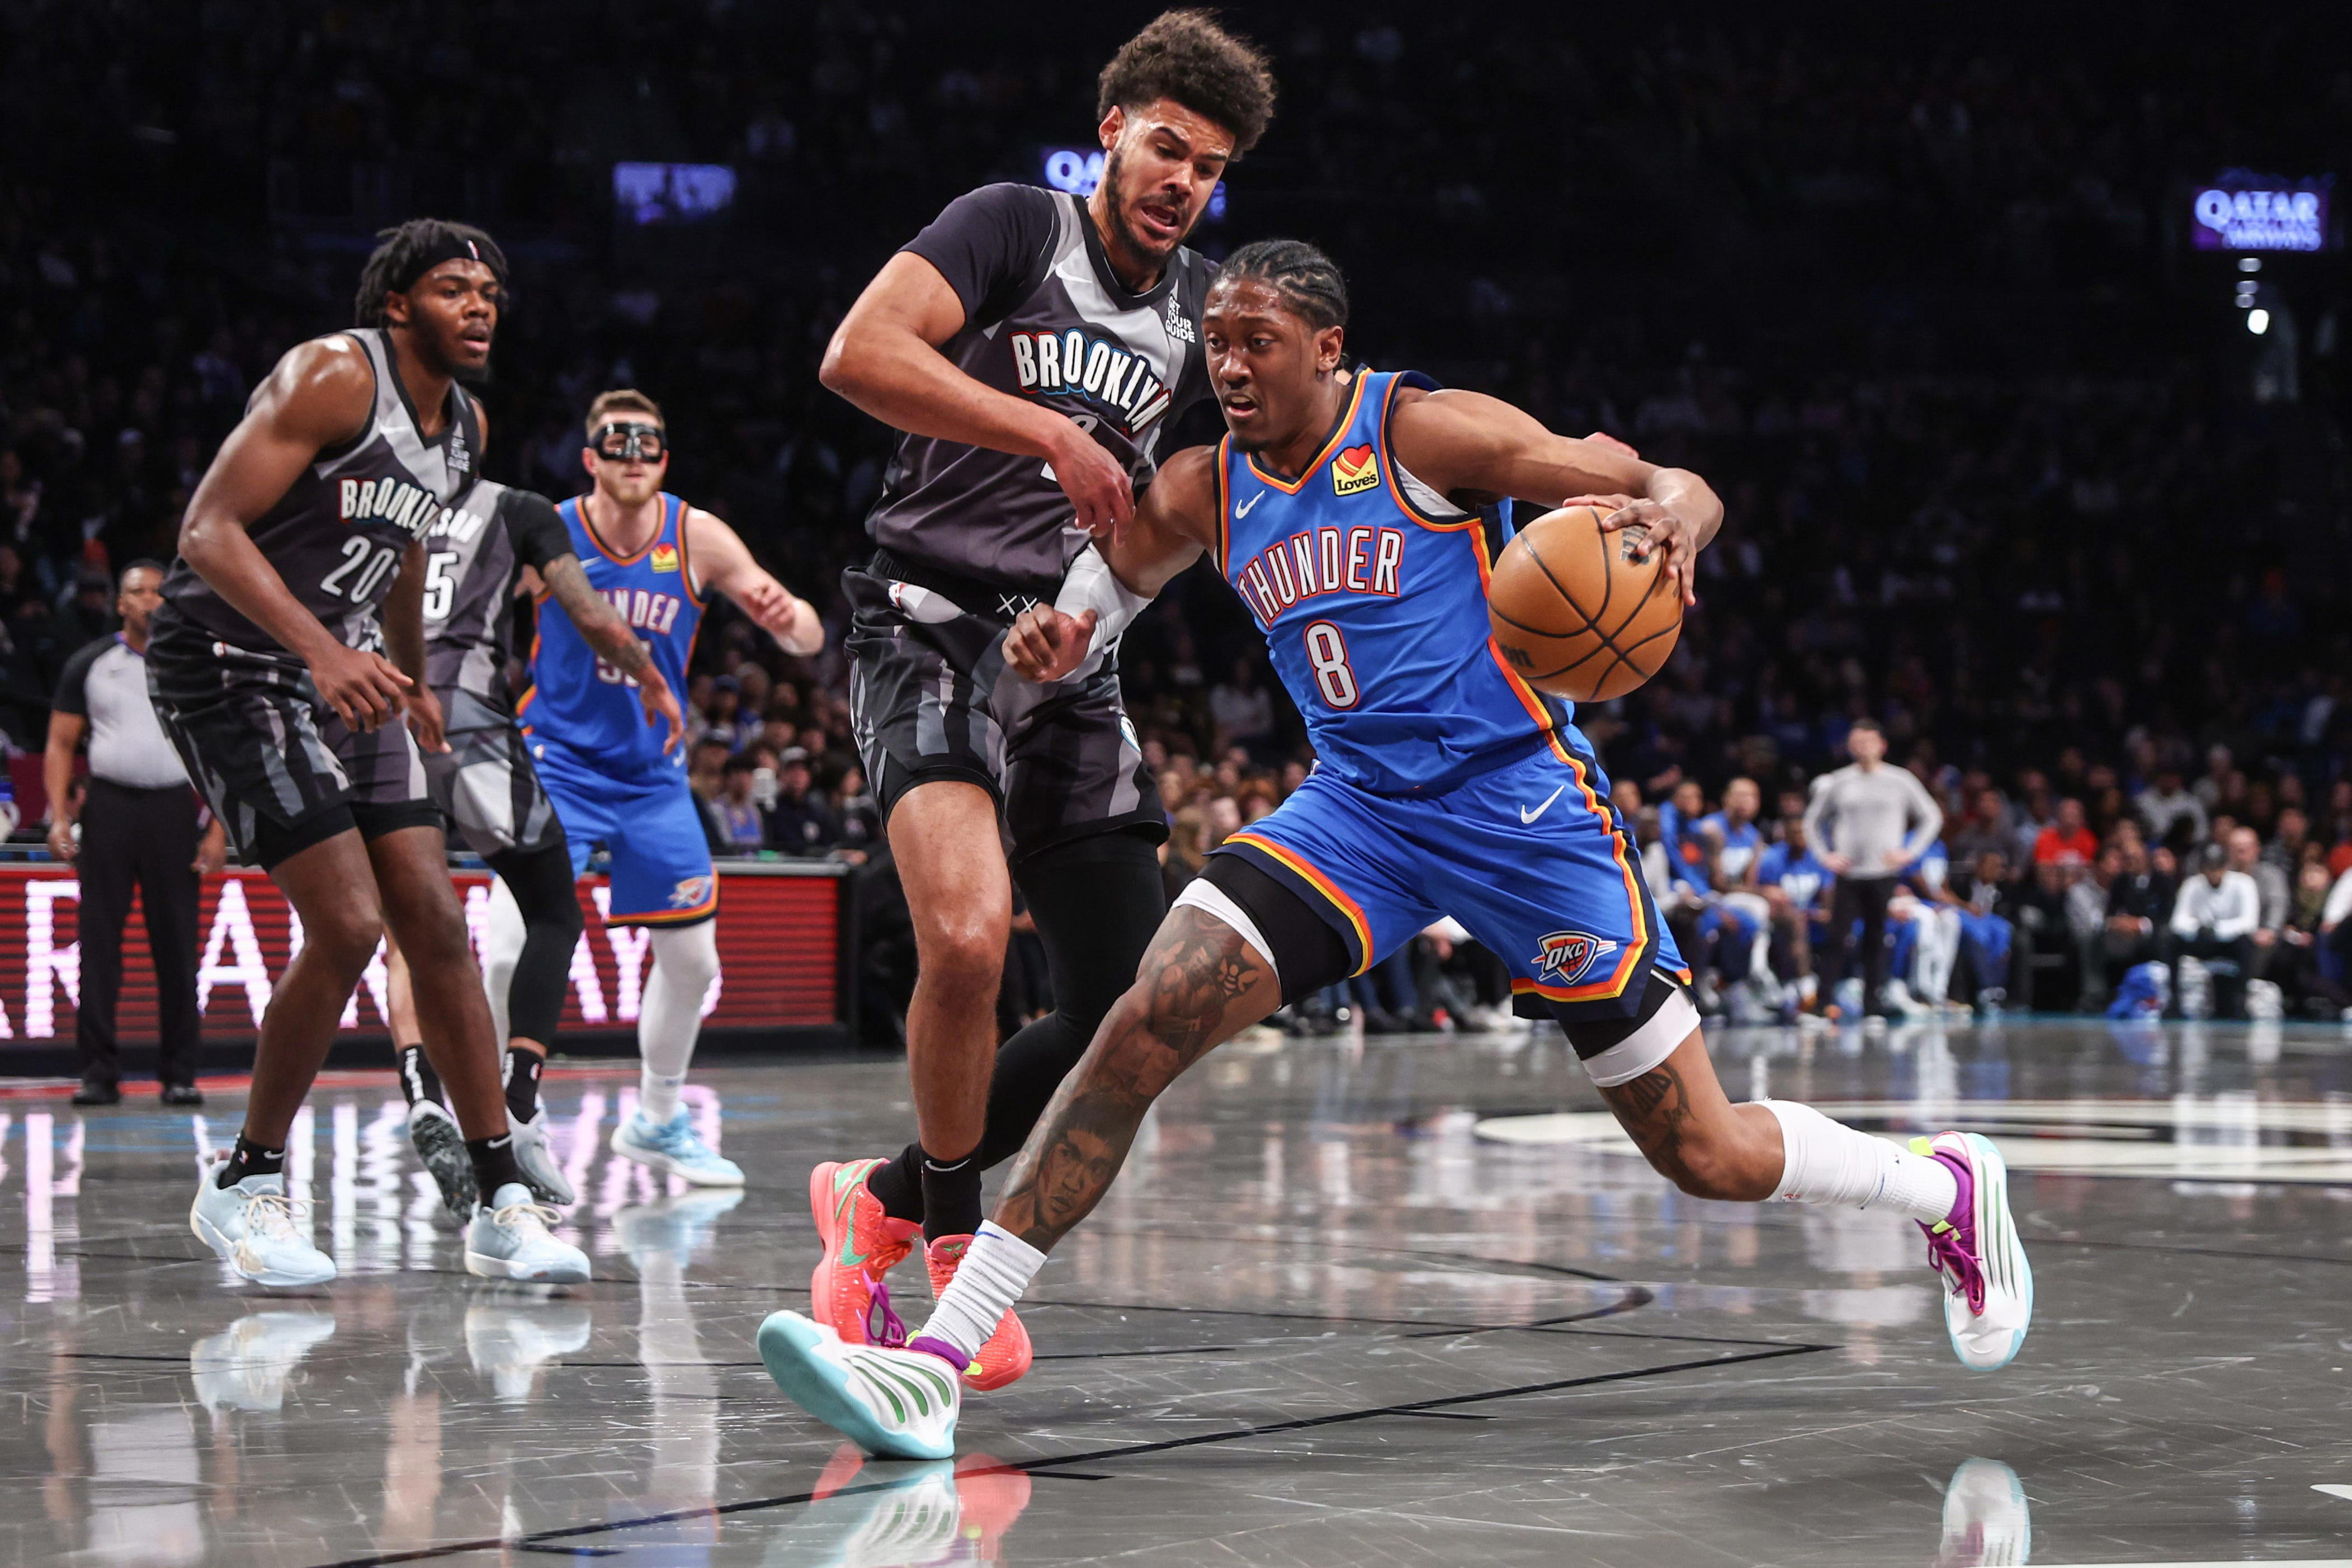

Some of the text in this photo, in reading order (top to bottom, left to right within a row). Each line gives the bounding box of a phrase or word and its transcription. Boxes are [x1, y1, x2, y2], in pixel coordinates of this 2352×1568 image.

[1168, 296, 1180, 314] GET
[1168, 307, 1192, 331] YOUR
[1165, 319, 1196, 343] GUIDE
[1010, 330, 1172, 434] BROOKLYN
[320, 535, 396, 604] 20
[1238, 526, 1404, 630] THUNDER
[1305, 620, 1359, 709] 8
[1545, 942, 1585, 971] OKC
